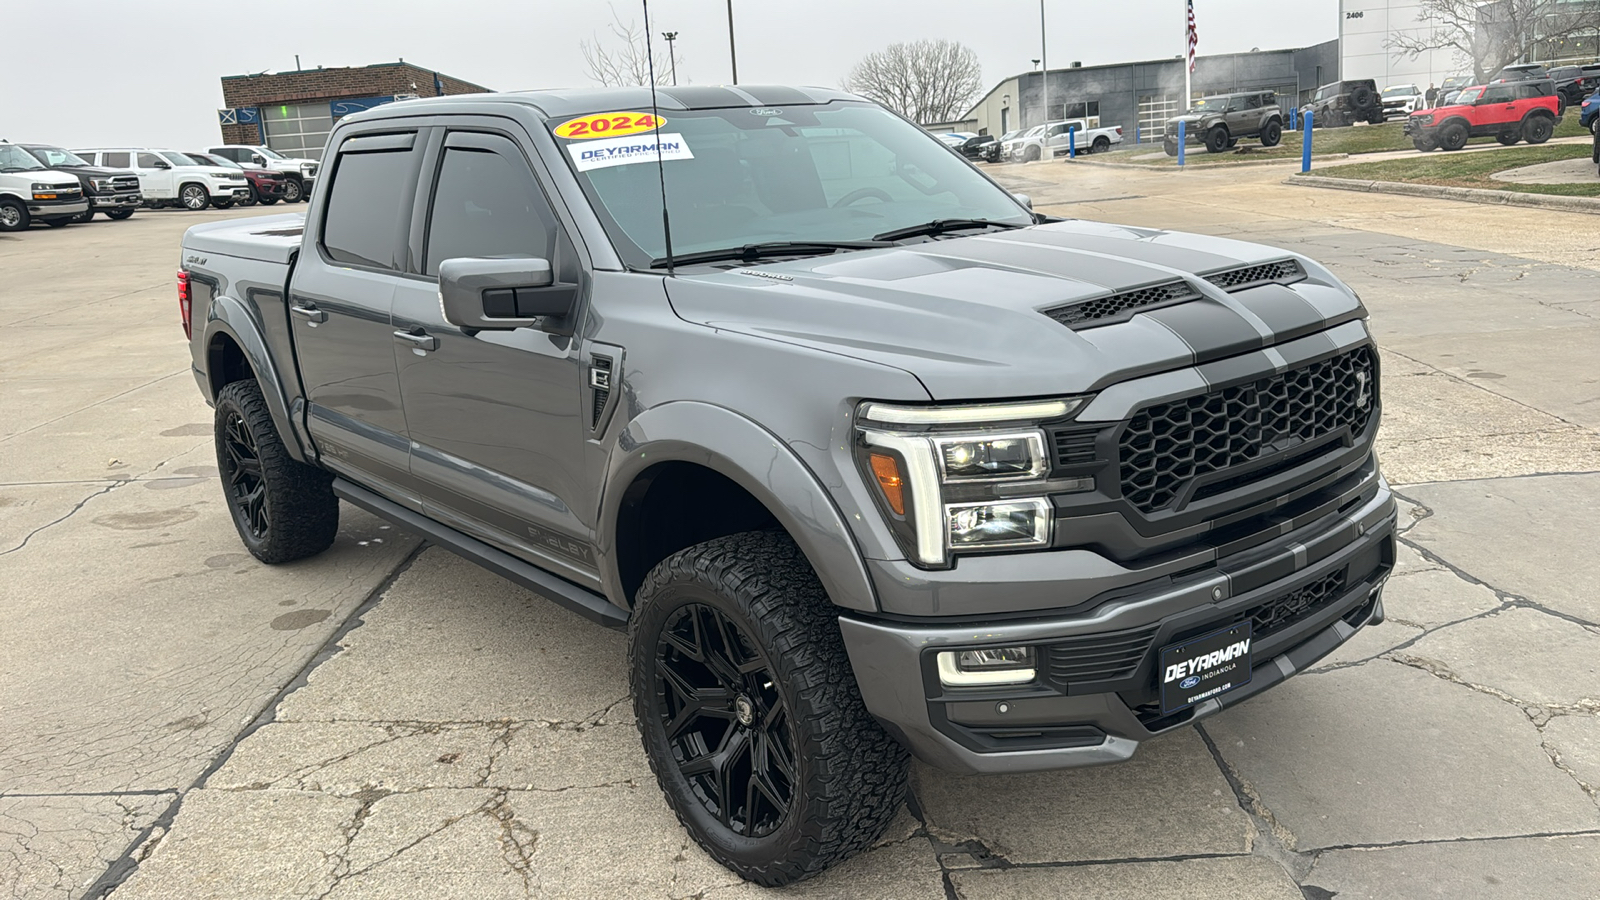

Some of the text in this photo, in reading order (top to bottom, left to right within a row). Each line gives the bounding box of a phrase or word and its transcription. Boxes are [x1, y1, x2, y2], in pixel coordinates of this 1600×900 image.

[1346, 11, 1364, 19] 2406
[568, 114, 655, 136] 2024
[581, 142, 680, 160] DEYARMAN
[590, 153, 633, 163] CERTIFIED
[1164, 638, 1250, 683] DEYARMAN
[1201, 662, 1237, 681] INDIANOLA
[1182, 677, 1198, 688] Ford
[1187, 682, 1231, 703] DEYARMANFORD.COM
